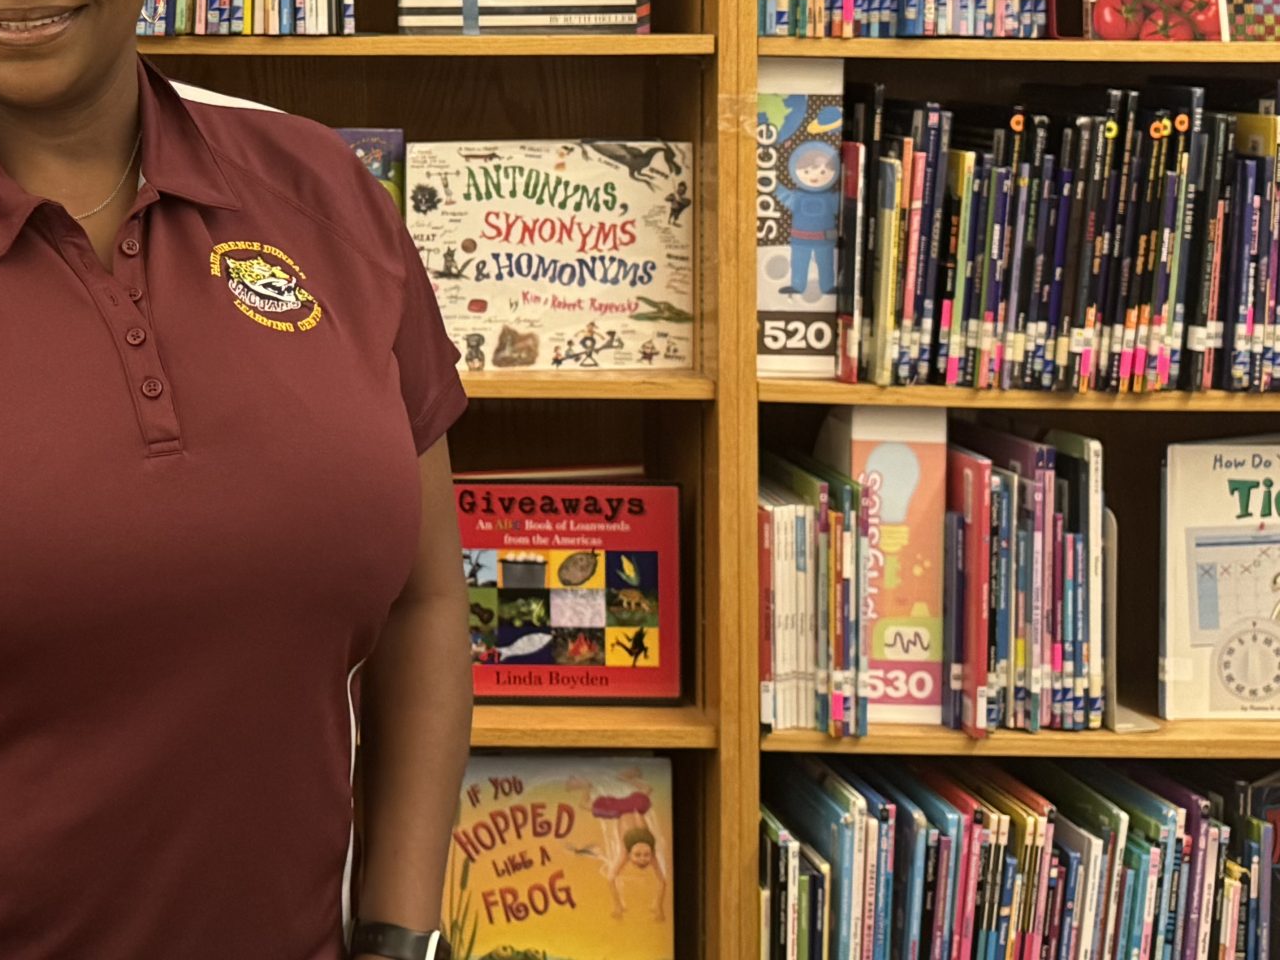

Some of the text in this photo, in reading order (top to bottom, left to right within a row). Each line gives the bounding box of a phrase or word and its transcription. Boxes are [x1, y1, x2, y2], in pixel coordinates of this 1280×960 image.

[463, 164, 629, 216] ANTONYMS,
[756, 122, 782, 240] space
[480, 211, 638, 253] SYNONYMS
[474, 260, 491, 283] &
[491, 251, 657, 288] HOMONYMS
[763, 319, 833, 350] 520
[1213, 453, 1272, 471] How Do
[458, 489, 646, 521] Giveaways
[476, 519, 493, 531] An
[525, 519, 553, 531] Book
[555, 519, 568, 531] of
[569, 520, 630, 532] Loanwords
[503, 534, 603, 546] from the Americas
[495, 671, 610, 689] Linda Boyden
[867, 669, 934, 699] 530
[467, 776, 524, 809] IF YOU
[453, 803, 576, 863] HOPPED
[492, 846, 552, 878] LIKE A
[482, 869, 578, 925] FROG
